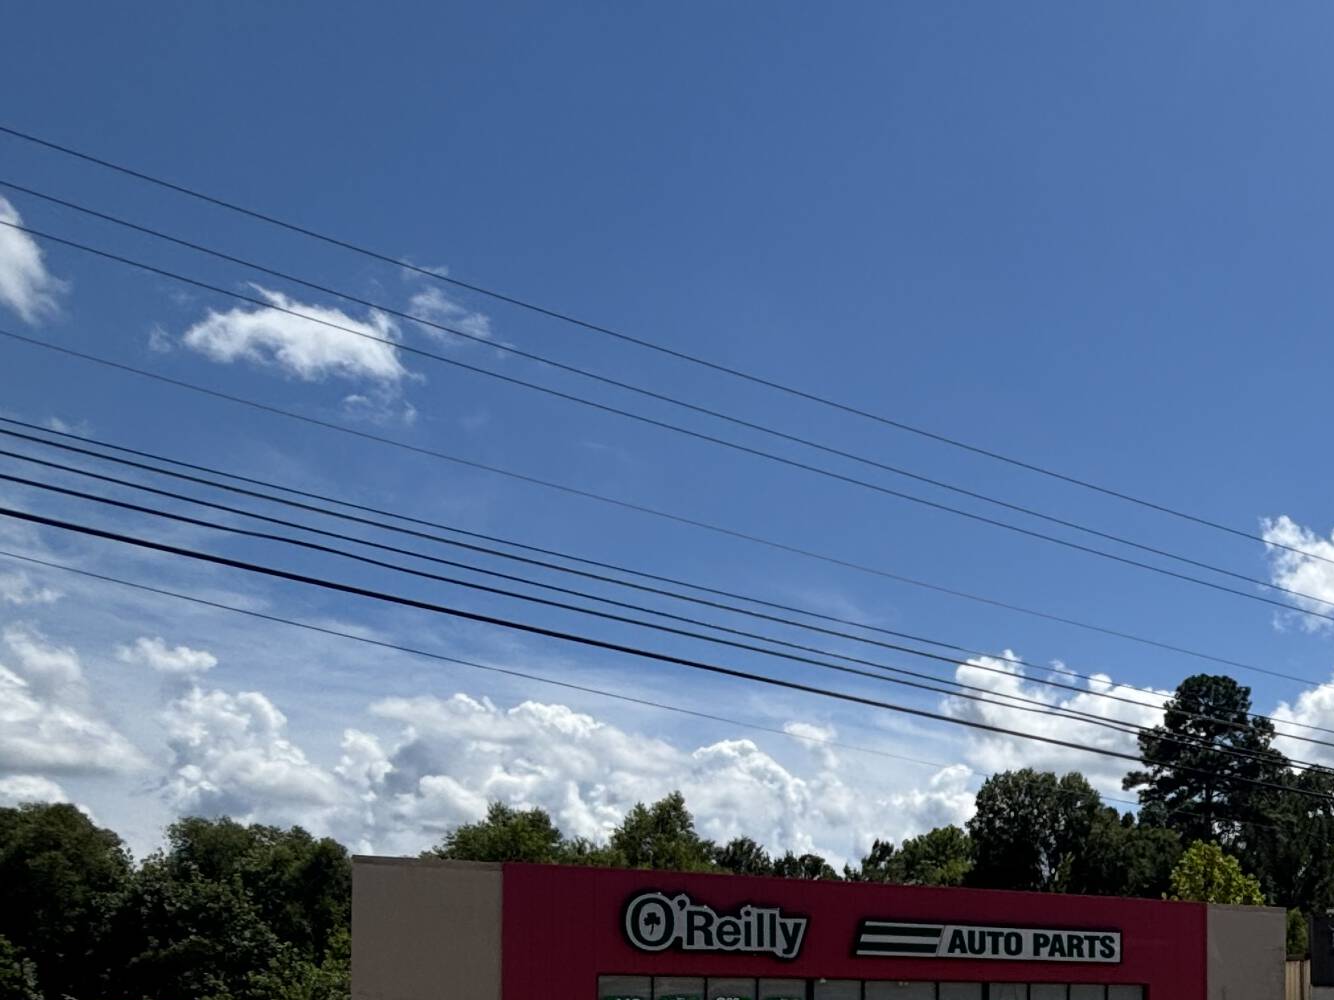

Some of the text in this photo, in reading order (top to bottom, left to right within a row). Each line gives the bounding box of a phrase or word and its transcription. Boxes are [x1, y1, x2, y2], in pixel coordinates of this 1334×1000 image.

[628, 894, 806, 958] O'Reilly
[947, 928, 1116, 959] AUTO PARTS
